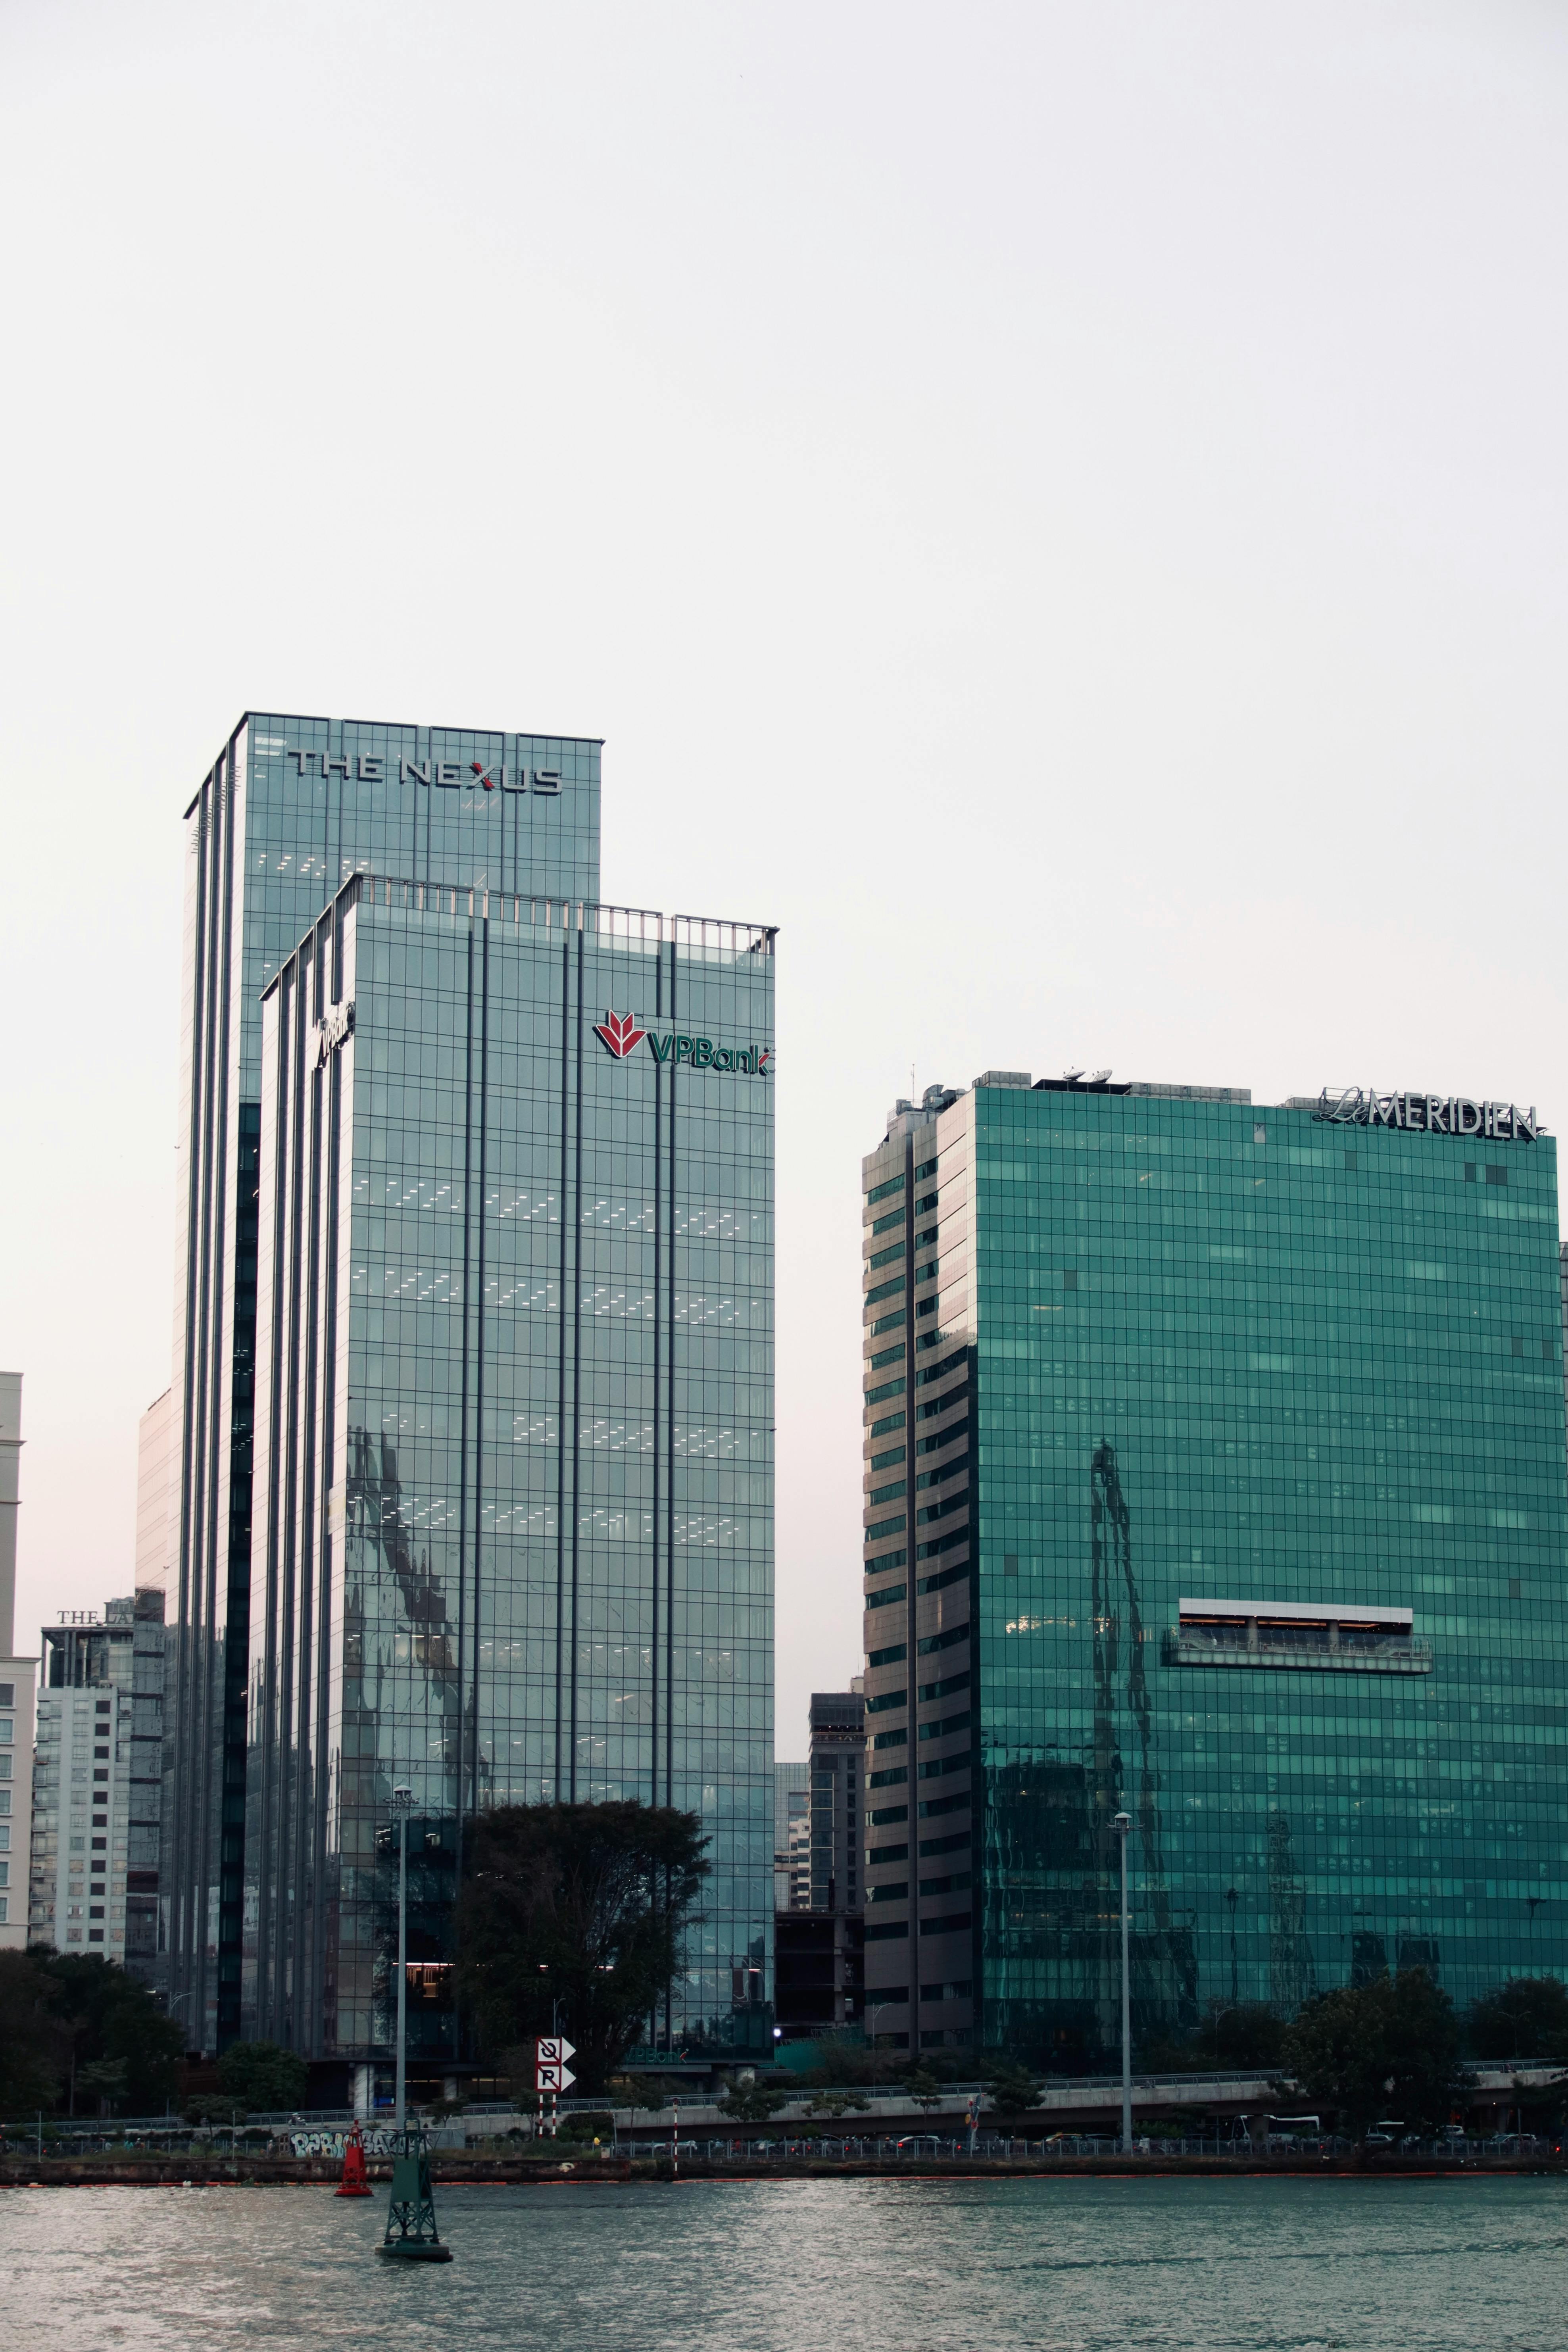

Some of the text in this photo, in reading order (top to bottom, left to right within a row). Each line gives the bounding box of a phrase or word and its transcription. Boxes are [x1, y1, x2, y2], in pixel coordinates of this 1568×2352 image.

[288, 748, 563, 794] THE NEXUS
[648, 1032, 771, 1074] VPBank
[1319, 1086, 1537, 1142] Le MERIDIEN
[57, 1602, 134, 1624] THE LA
